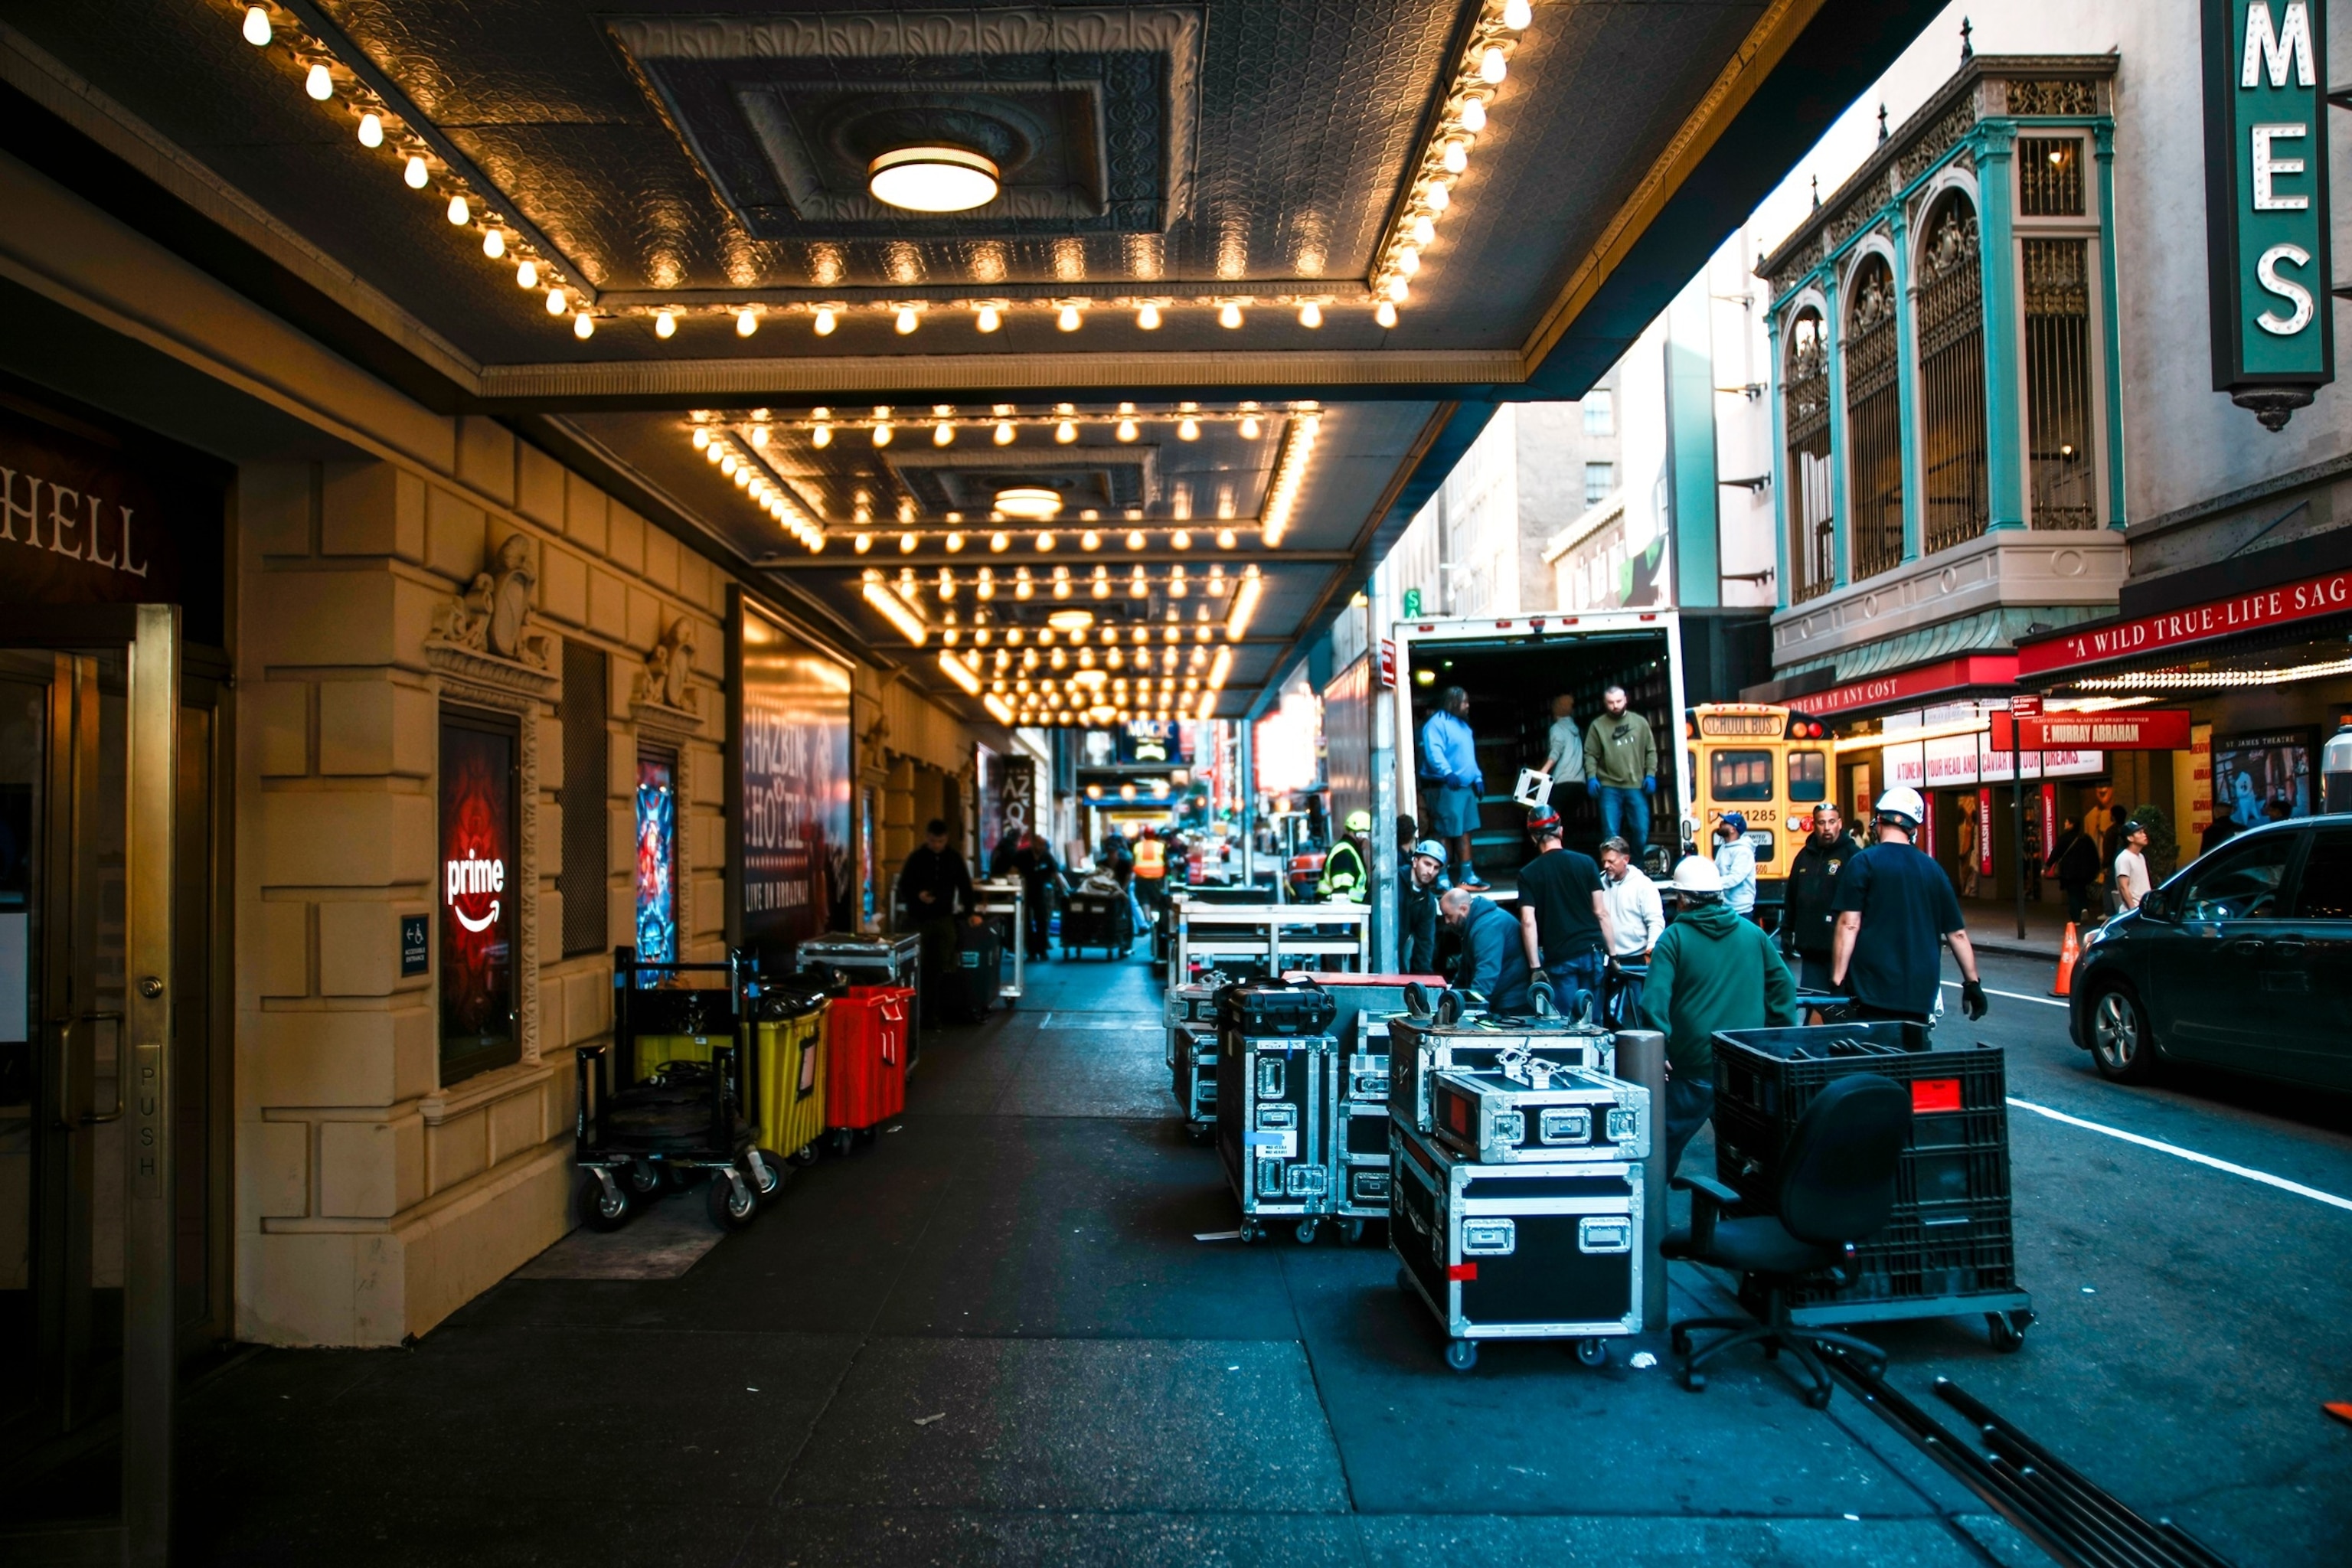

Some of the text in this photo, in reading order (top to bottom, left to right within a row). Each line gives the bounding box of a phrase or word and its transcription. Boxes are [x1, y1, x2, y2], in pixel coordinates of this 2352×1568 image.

[0, 466, 148, 578] HELL
[2095, 624, 2145, 651] WILD
[2154, 592, 2282, 641] TRUE-LIFE
[2295, 577, 2347, 610] SAG
[1791, 678, 1898, 713] DREAM AT ANY COST
[1705, 717, 1772, 734] SCHOOL BUS
[2043, 724, 2139, 743] F. MURRAY ABRAHAM
[2238, 738, 2259, 747] JAMES
[2262, 735, 2295, 745] THEATRE
[1896, 763, 1901, 780] A
[1902, 762, 1916, 780] TUNE
[1916, 760, 1922, 778] IN
[1926, 759, 1943, 778] YOUR
[1963, 754, 1977, 774] AND
[1981, 752, 2007, 773] CAVIAR
[2045, 751, 2080, 767] DREAMS.
[1728, 810, 1776, 822] 1285
[448, 848, 505, 906] prime
[746, 883, 762, 912] LIVE
[765, 882, 774, 909] ON
[404, 947, 426, 956] ACCESSIBLE
[405, 954, 425, 963] ENTRANCE
[140, 1067, 155, 1175] PUSH
